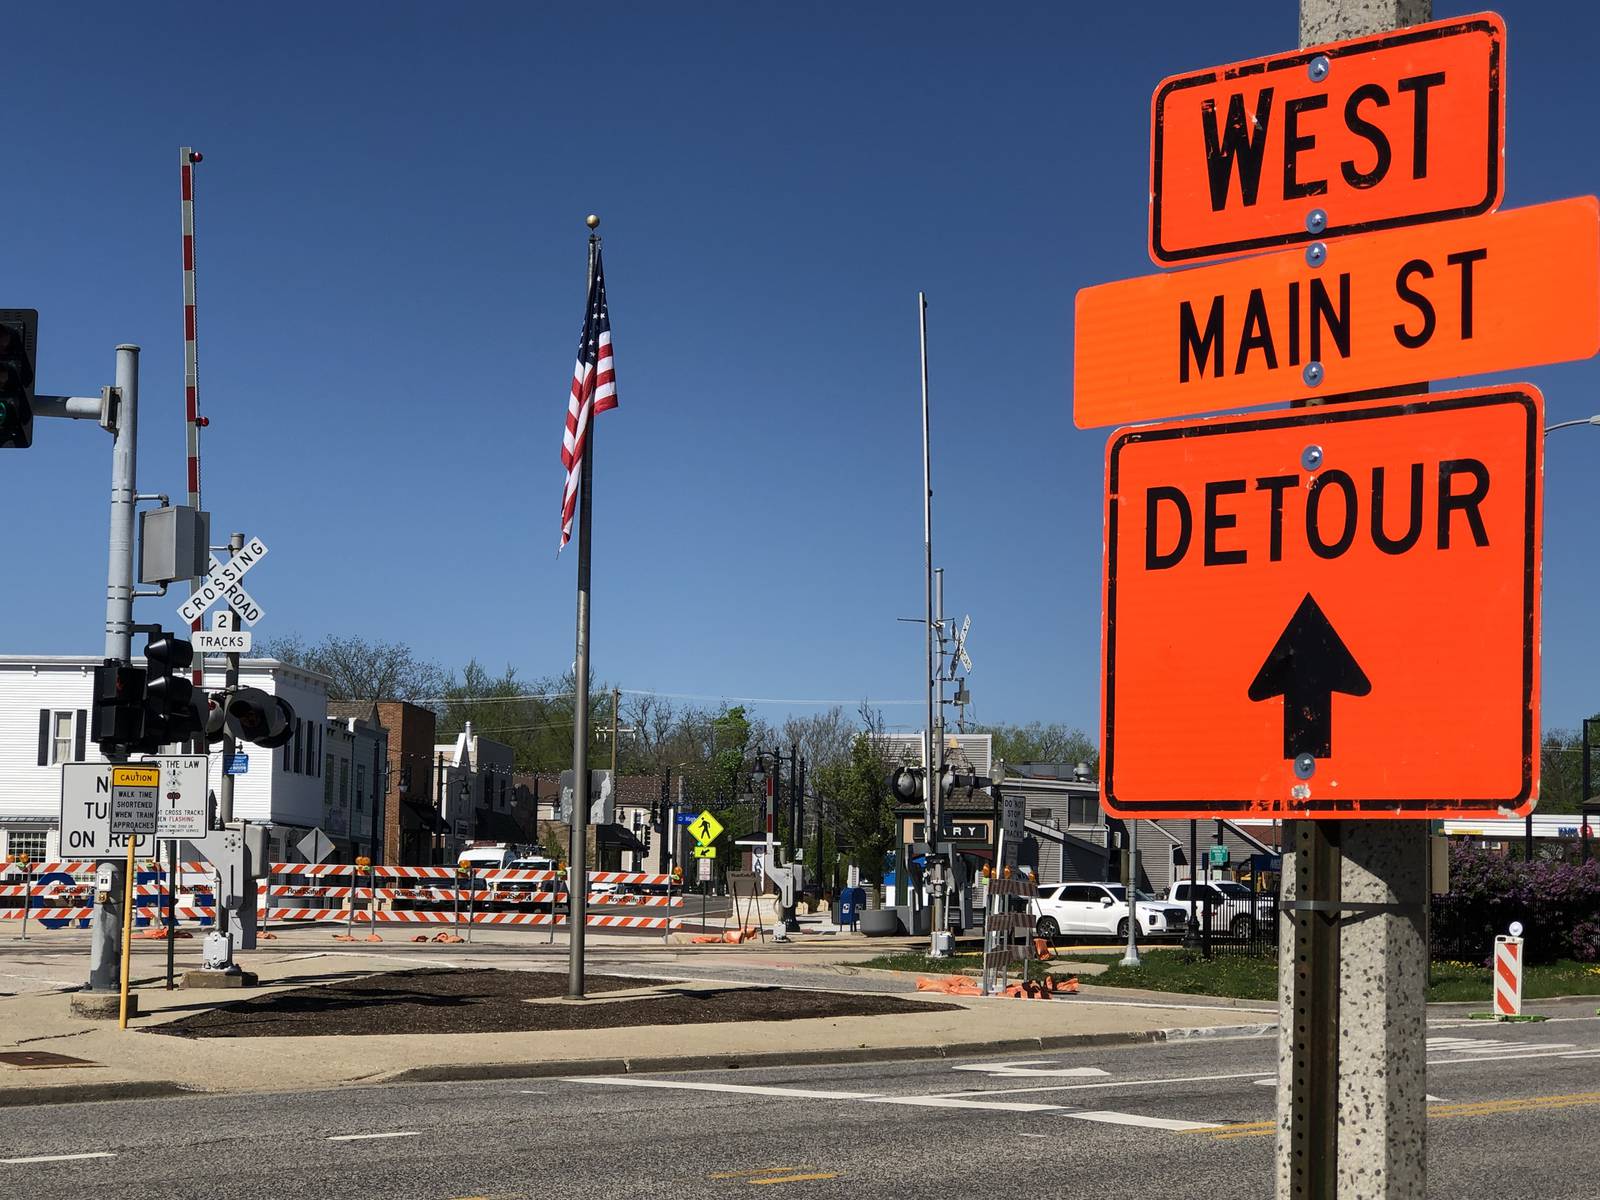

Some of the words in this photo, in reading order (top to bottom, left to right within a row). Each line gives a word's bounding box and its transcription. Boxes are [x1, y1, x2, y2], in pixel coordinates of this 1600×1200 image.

[1201, 72, 1445, 212] WEST
[1180, 273, 1351, 383] MAIN
[1394, 248, 1487, 349] ST
[1145, 458, 1490, 571] DETOUR
[182, 542, 263, 620] CROSSING
[224, 584, 259, 621] ROAD
[217, 615, 227, 628] 2
[200, 636, 244, 647] TRACKS
[166, 760, 180, 768] THE
[184, 760, 199, 768] LAW
[96, 776, 111, 793] N
[120, 774, 152, 782] CAUTION
[84, 802, 111, 819] TU
[117, 801, 153, 809] SHORTENED
[1005, 799, 1012, 807] DO
[113, 821, 154, 829] APPROACHES
[69, 830, 95, 848] ON
